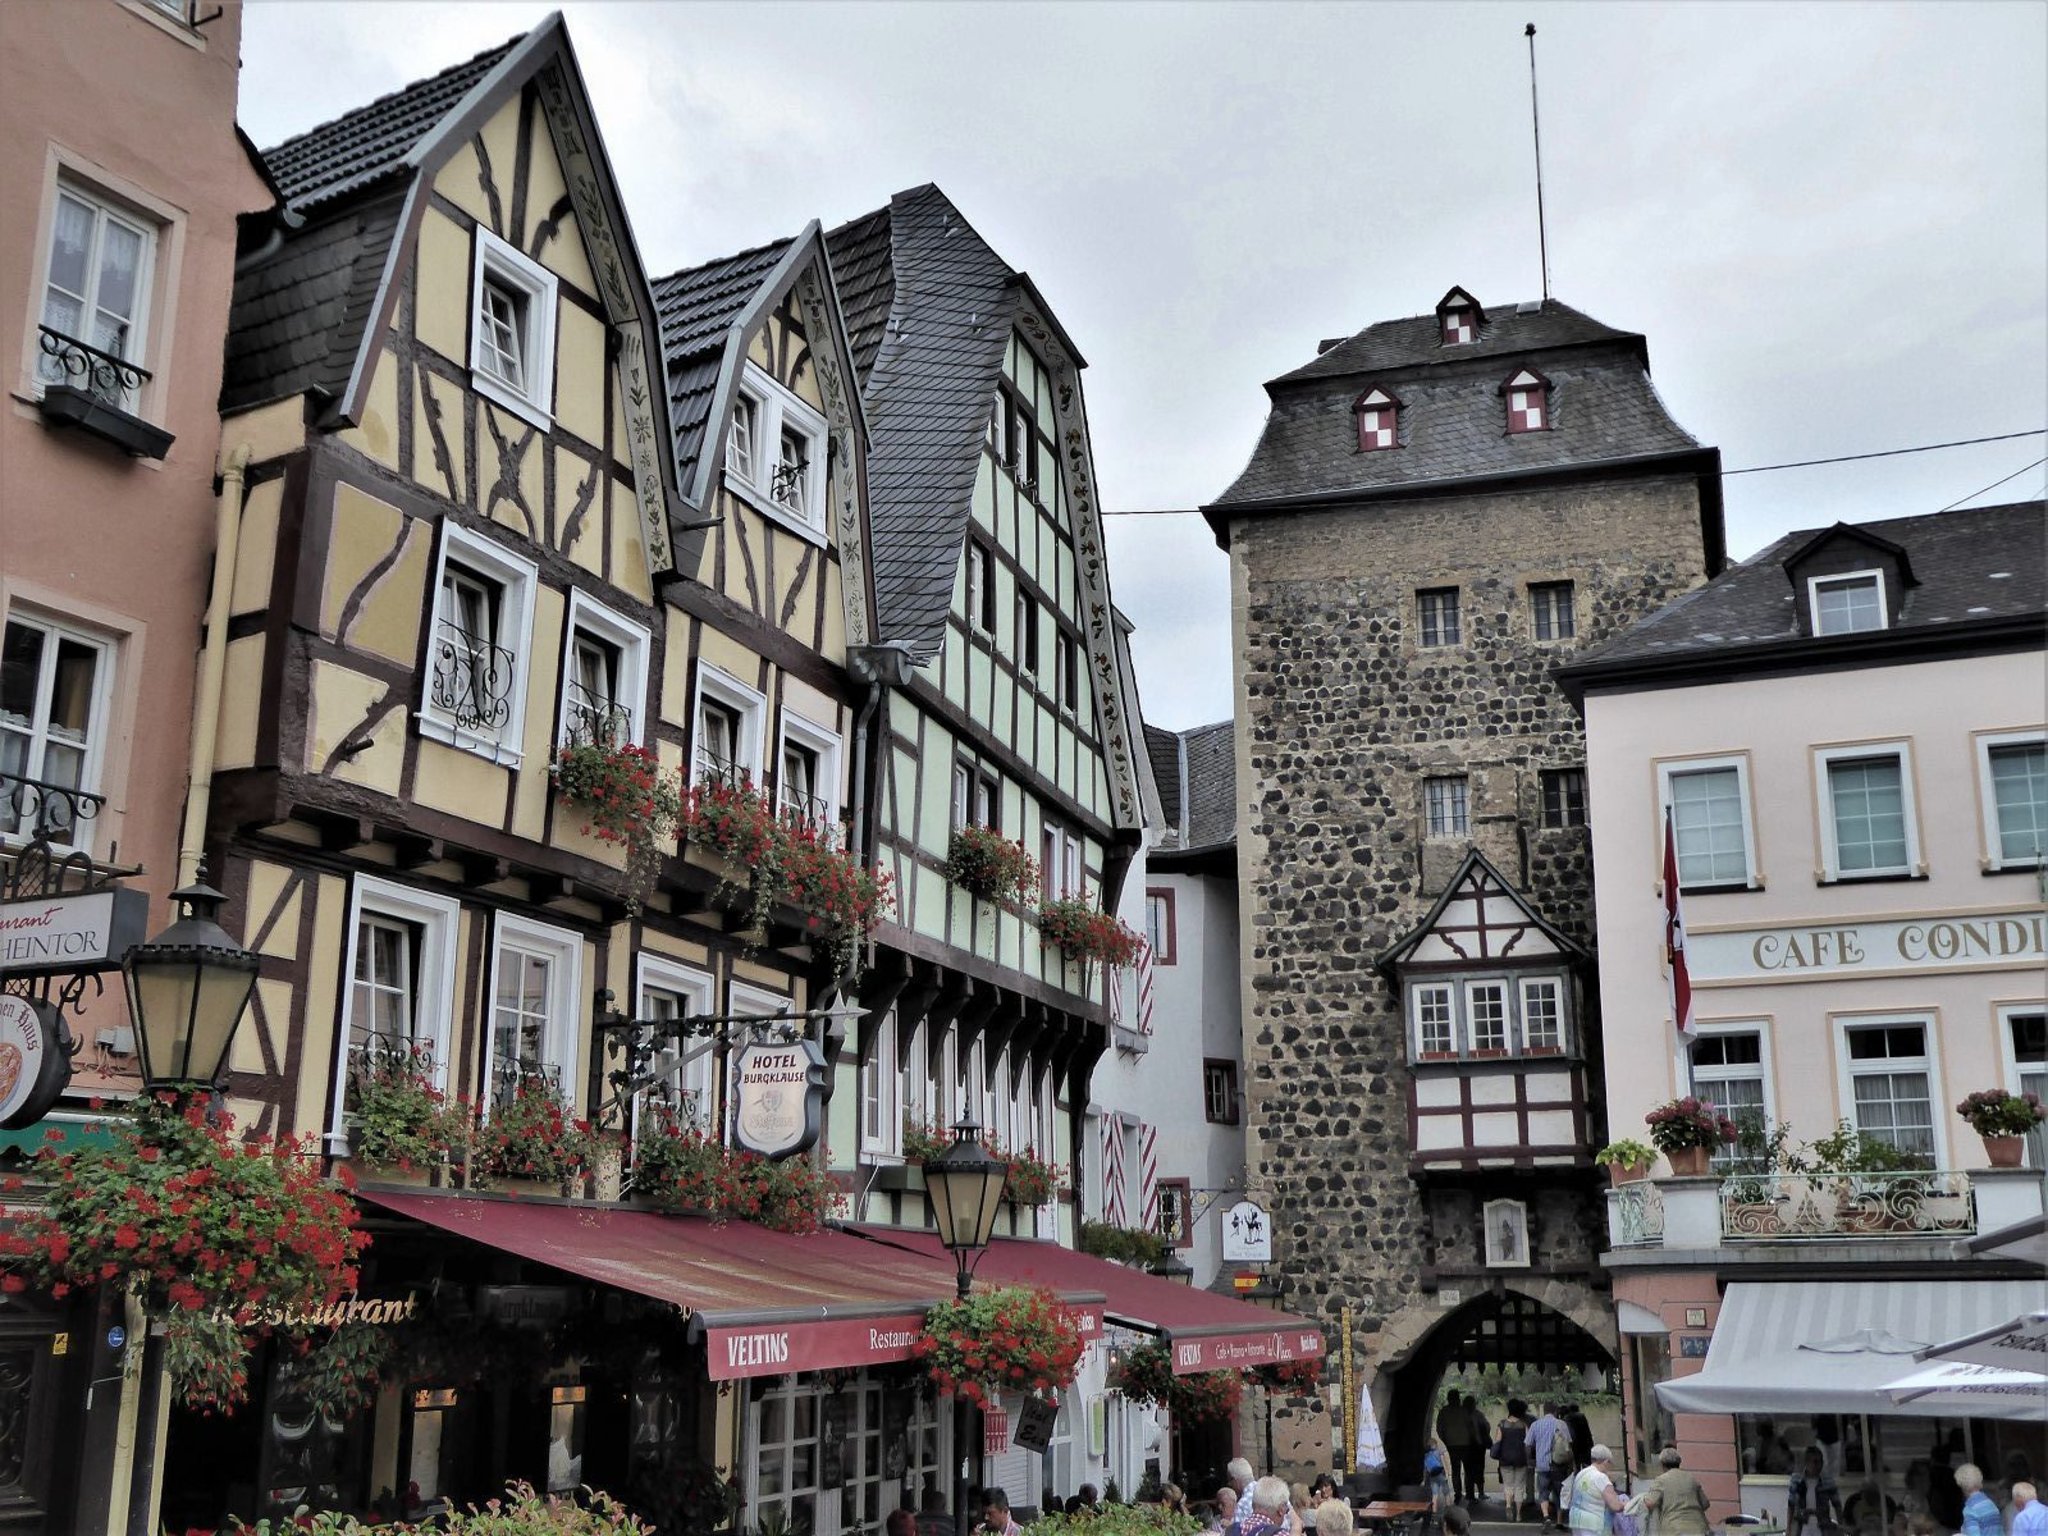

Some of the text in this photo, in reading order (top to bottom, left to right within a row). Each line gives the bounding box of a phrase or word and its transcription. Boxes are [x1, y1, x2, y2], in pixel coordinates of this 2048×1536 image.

[1752, 917, 2045, 970] CAFE CONDI
[752, 1054, 797, 1069] HOTEL
[743, 1071, 805, 1085] BURGKLAUSE
[727, 1327, 920, 1367] VELTINS Restauran
